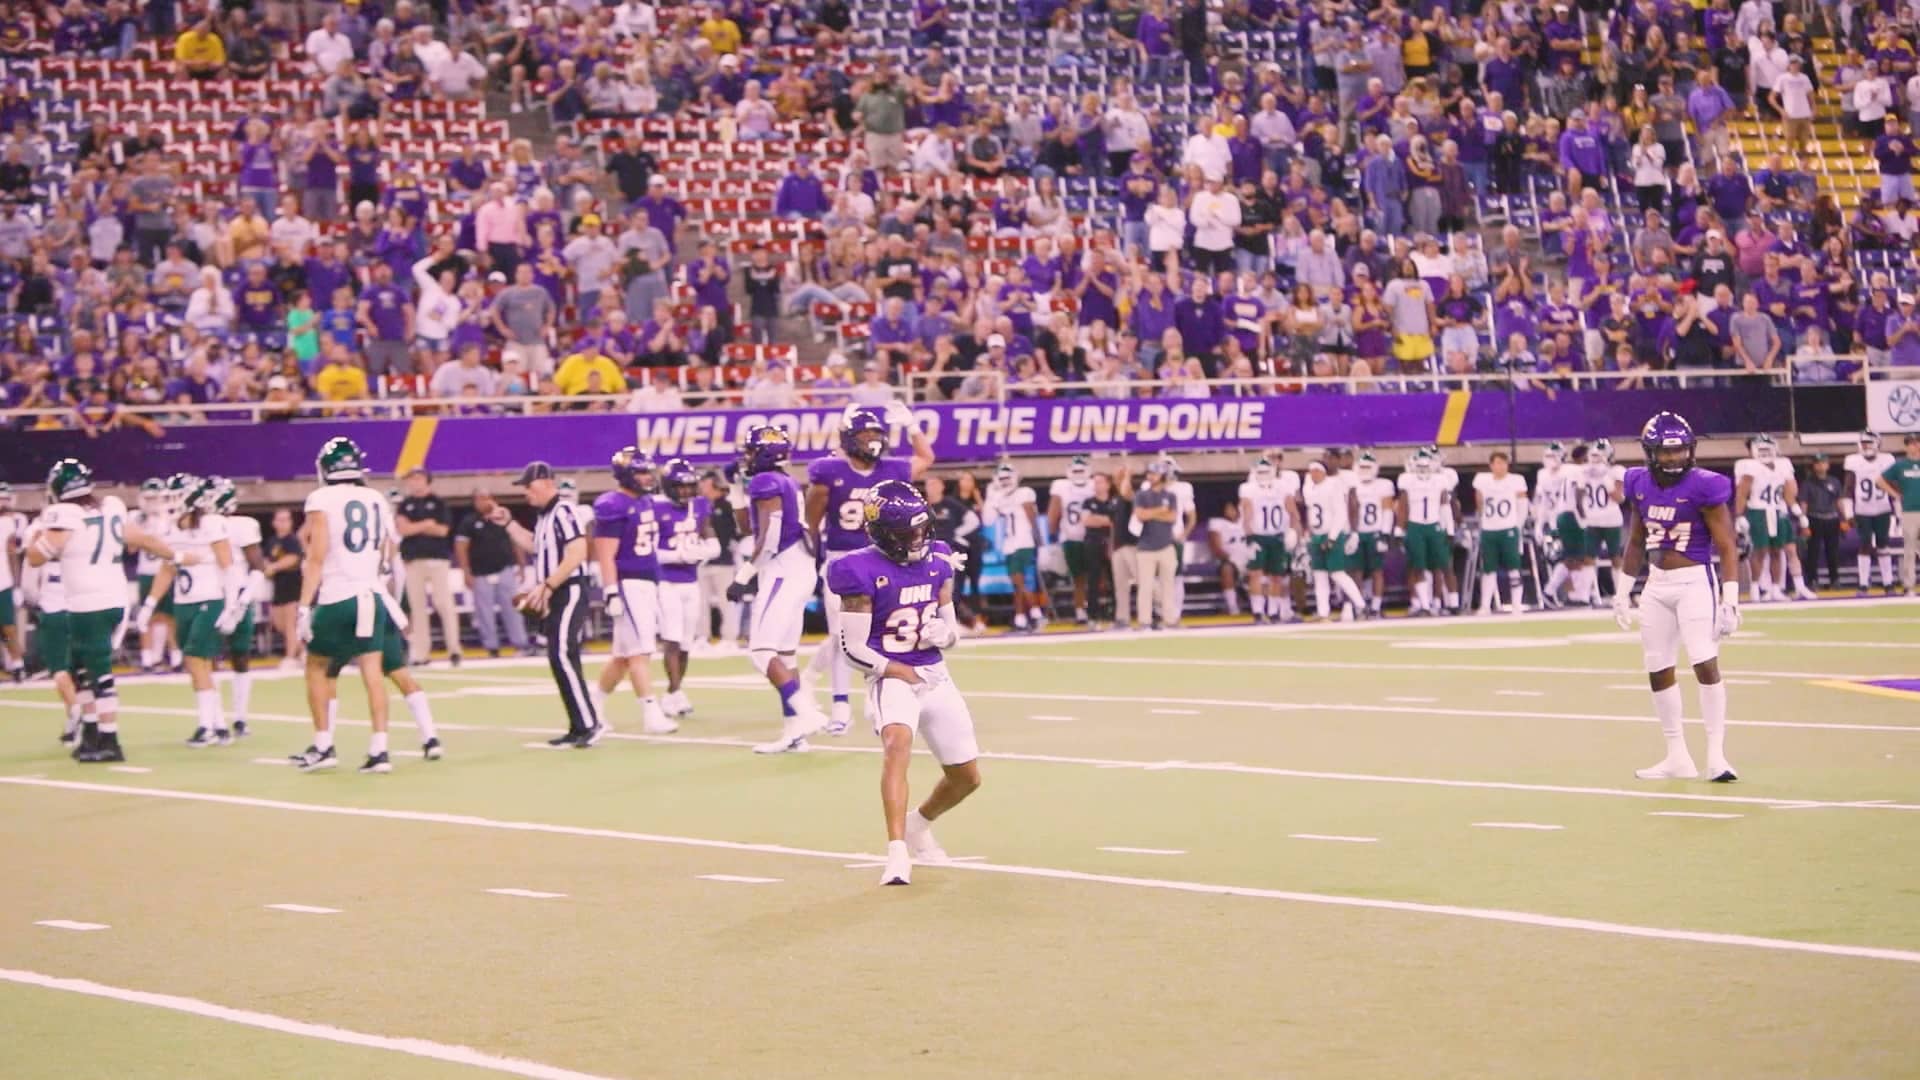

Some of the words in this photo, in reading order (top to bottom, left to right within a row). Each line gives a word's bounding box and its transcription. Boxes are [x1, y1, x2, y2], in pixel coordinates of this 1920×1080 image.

[636, 412, 843, 456] WELCOM
[884, 408, 940, 449] TO
[943, 406, 1037, 446] THE
[1050, 402, 1265, 444] UNI-DOME
[1261, 505, 1283, 531] 10
[1364, 503, 1378, 526] 8
[1422, 496, 1429, 520] 1
[1485, 496, 1512, 518] 50
[1648, 504, 1676, 521] UNI
[343, 500, 381, 553] 81
[899, 584, 933, 605] UNI
